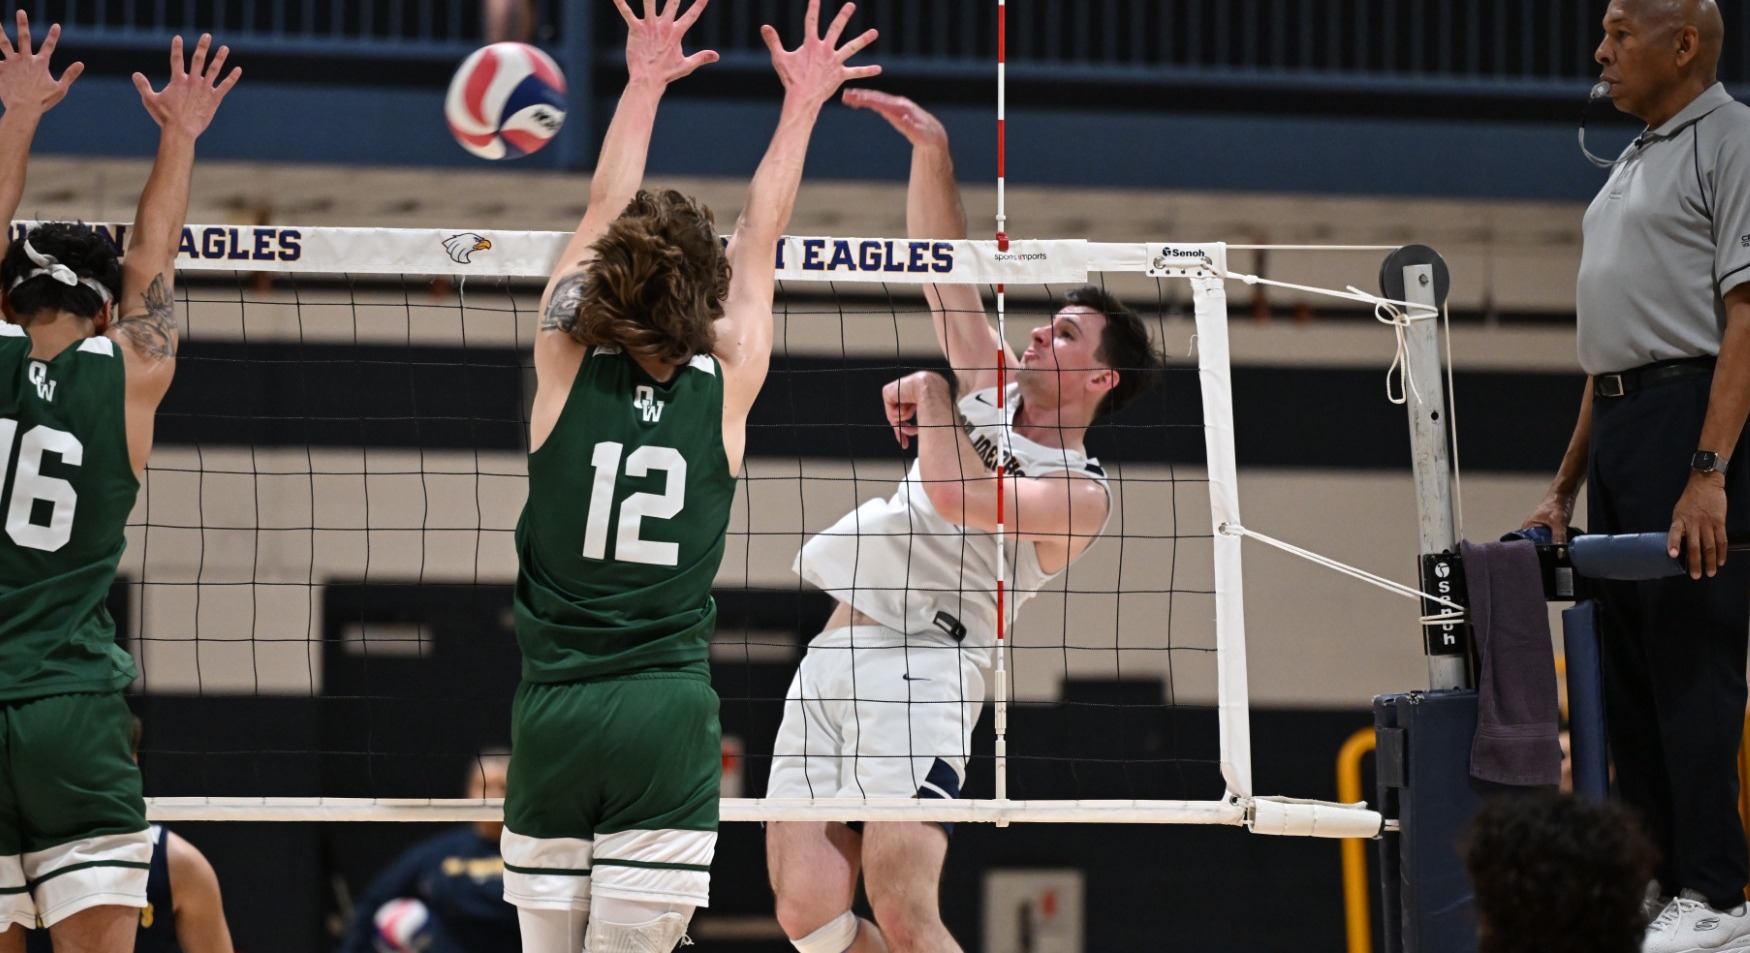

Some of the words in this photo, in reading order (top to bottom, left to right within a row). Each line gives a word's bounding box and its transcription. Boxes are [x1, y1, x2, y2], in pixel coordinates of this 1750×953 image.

[177, 227, 302, 261] AGLES
[802, 239, 954, 273] EAGLES
[1172, 248, 1205, 257] Senoh
[582, 441, 687, 566] 12
